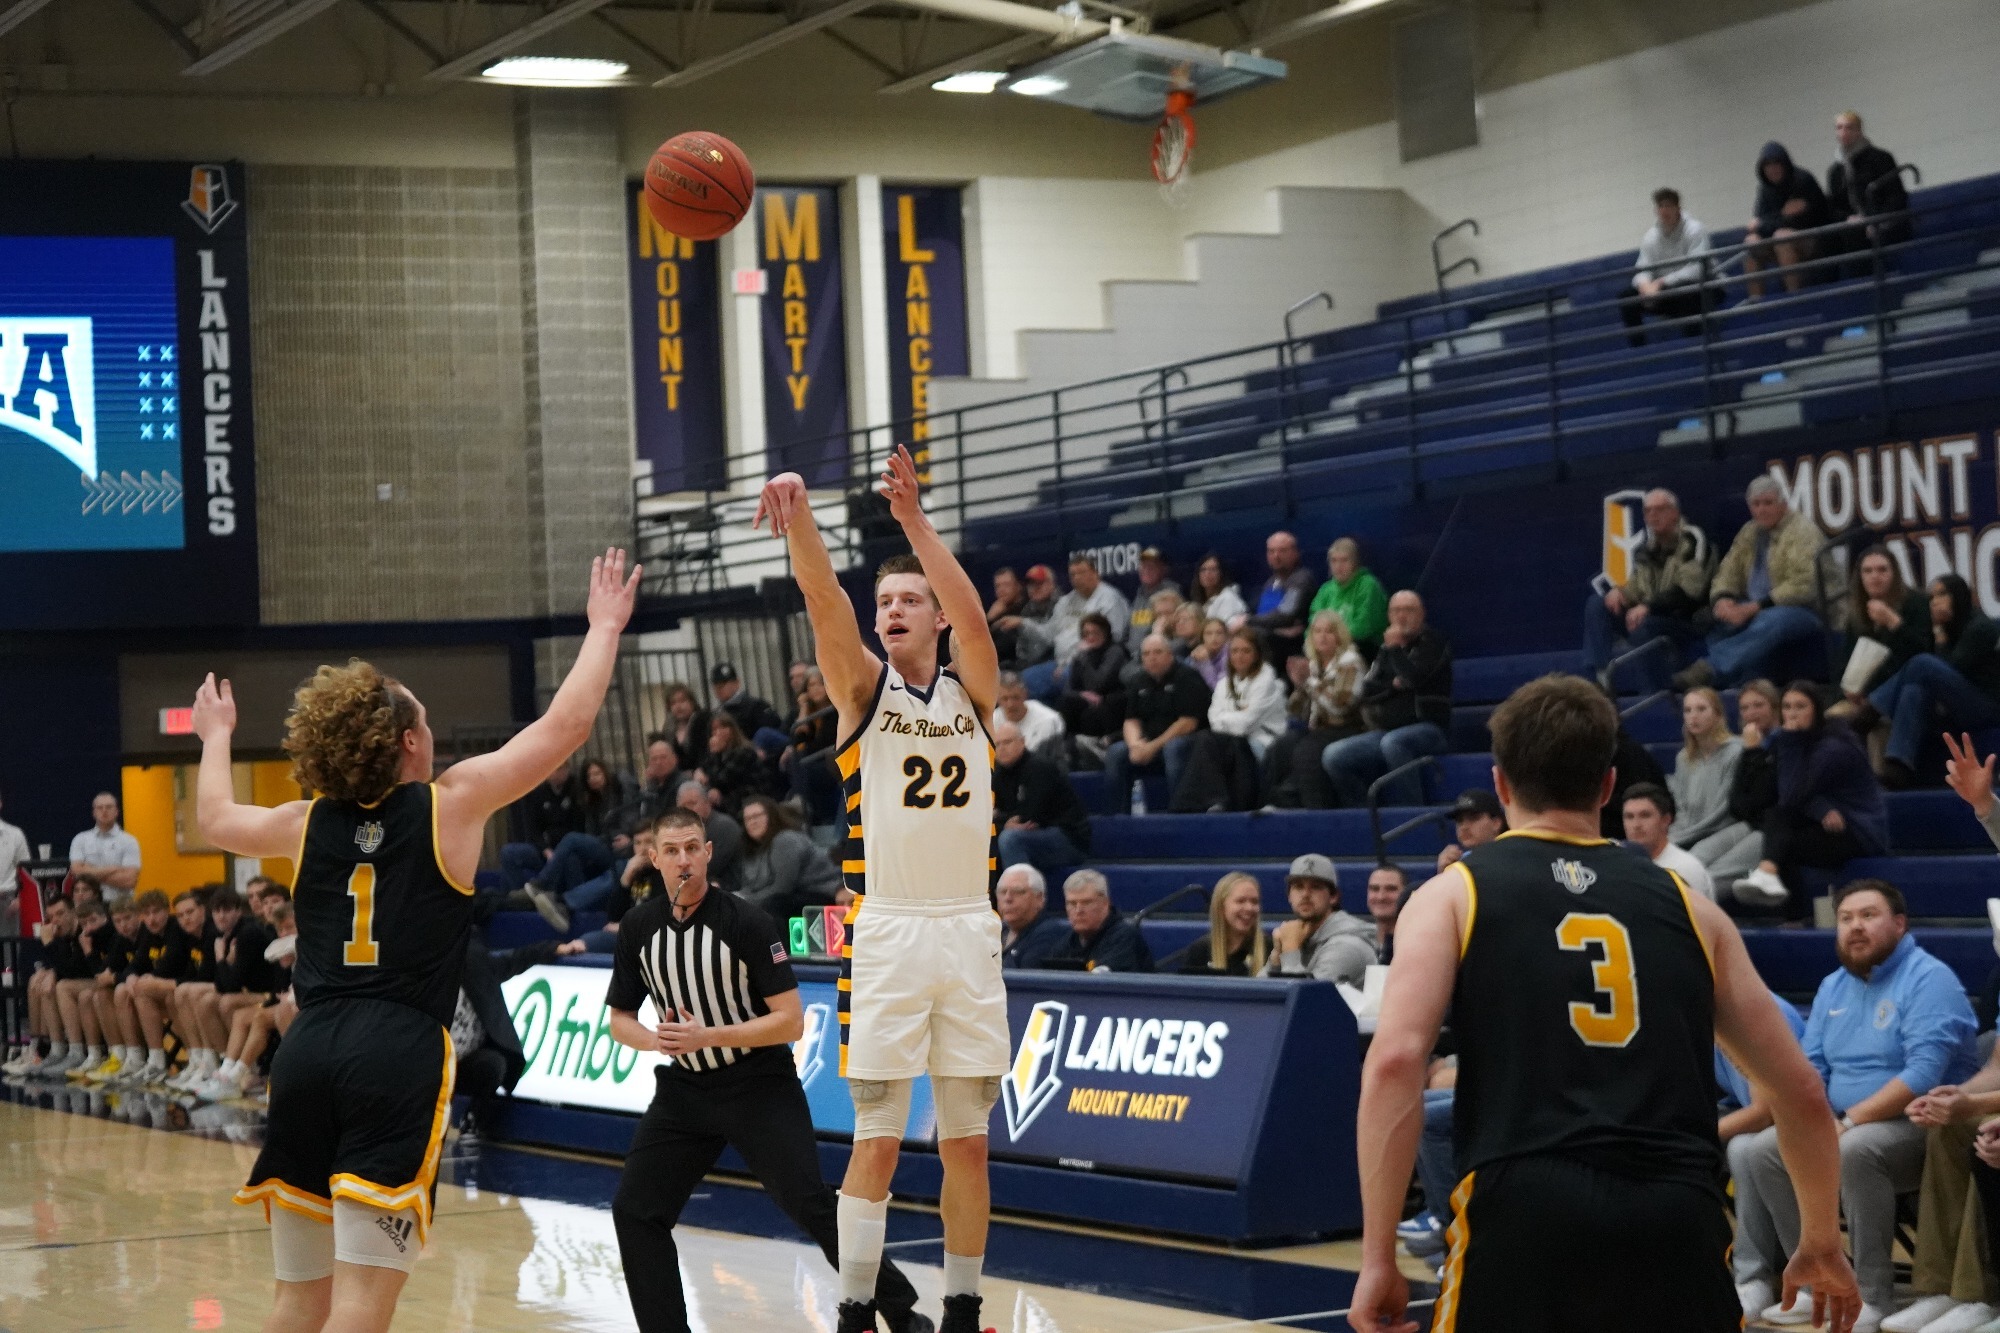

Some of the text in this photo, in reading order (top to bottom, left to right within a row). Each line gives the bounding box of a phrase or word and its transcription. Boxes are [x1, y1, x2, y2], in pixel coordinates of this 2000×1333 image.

[763, 193, 821, 411] MARTY
[198, 249, 237, 536] LANCERS
[1766, 437, 1978, 536] MOUNT
[1069, 542, 1140, 575] ITOR
[880, 710, 975, 740] The River City
[902, 753, 971, 810] 22
[343, 862, 380, 966] 1
[1555, 911, 1641, 1048] 3
[1064, 1014, 1230, 1079] LANCERS
[1067, 1087, 1191, 1123] MOUNT MARTY
